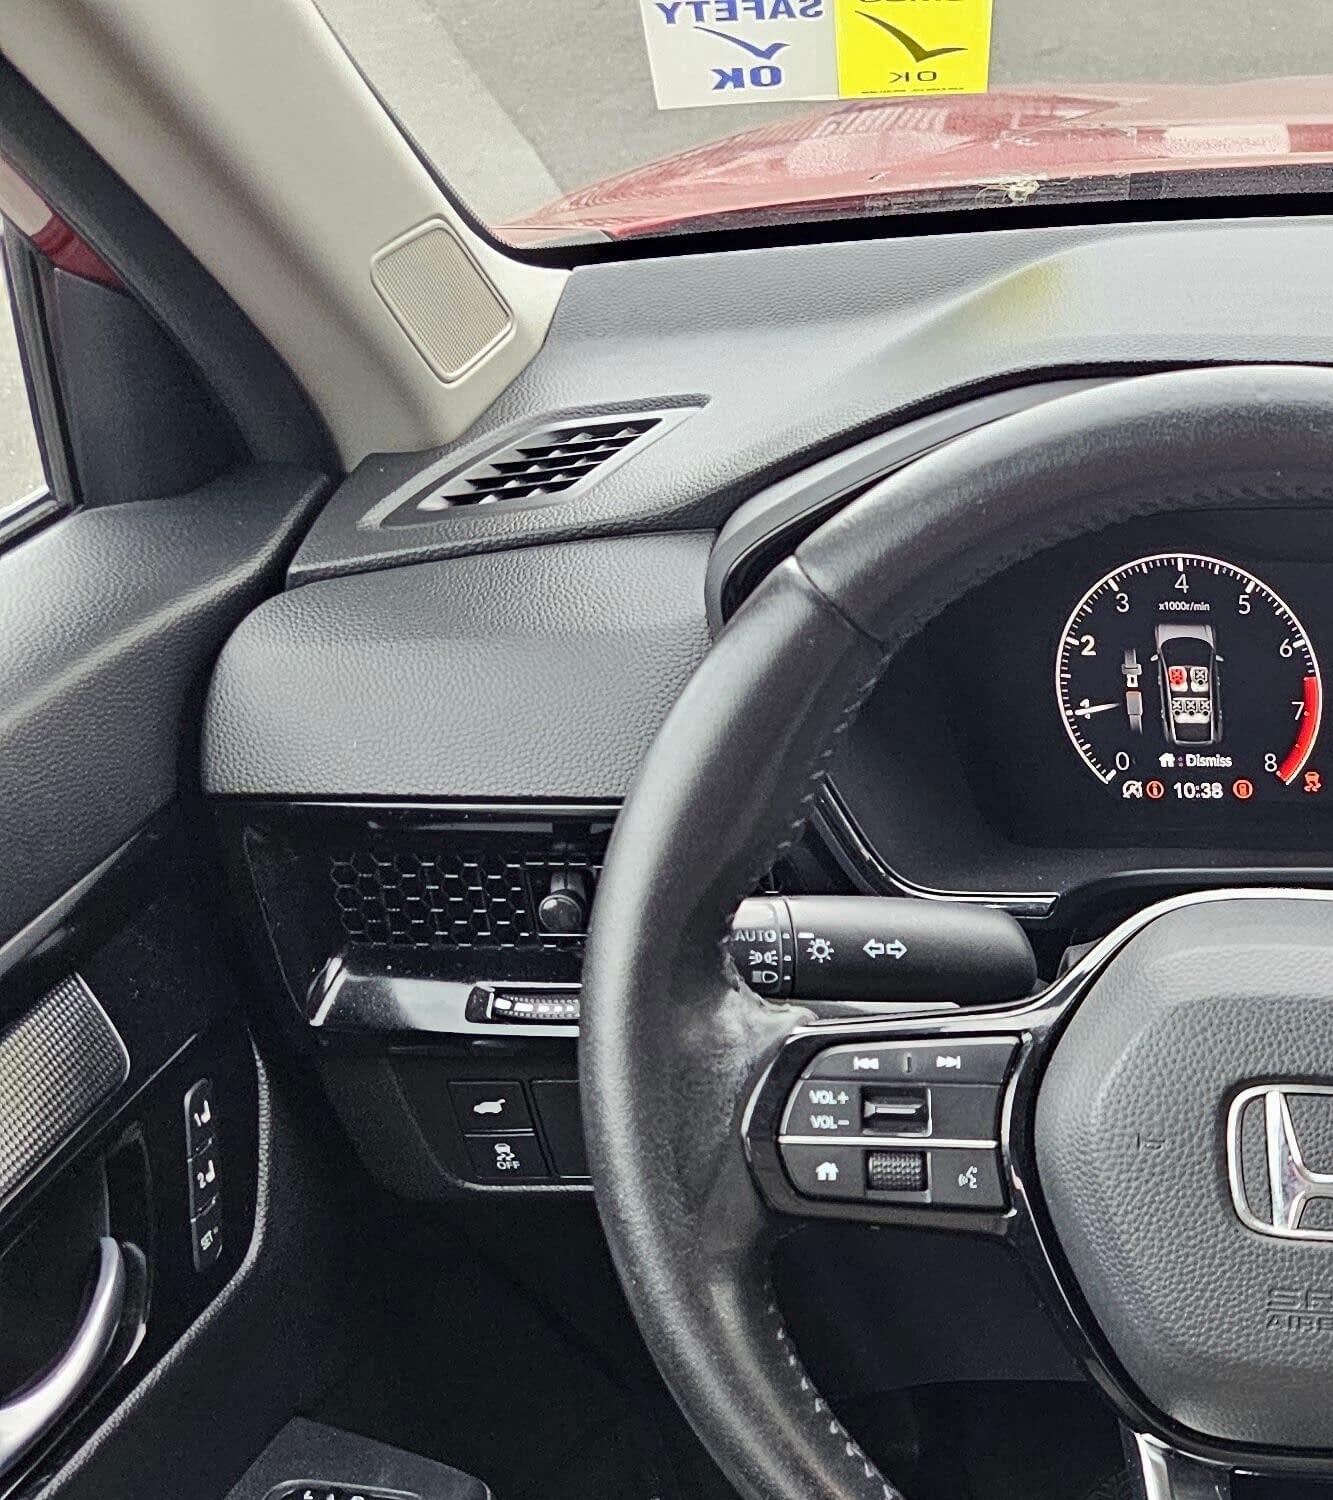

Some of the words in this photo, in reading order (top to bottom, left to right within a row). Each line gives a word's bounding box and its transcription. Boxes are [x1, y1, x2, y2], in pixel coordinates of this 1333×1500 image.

[1174, 575, 1189, 593] 4
[1115, 595, 1129, 612] 3
[1238, 596, 1251, 614] 5
[1080, 636, 1097, 656] 2
[1279, 639, 1293, 657] 6
[1291, 702, 1304, 720] 7
[1115, 752, 1130, 771] 0
[1186, 753, 1232, 768] Dismiss
[1264, 753, 1278, 771] 8
[1173, 782, 1223, 798] 10:38
[734, 930, 777, 943] AUTO
[496, 1161, 520, 1170] OFF
